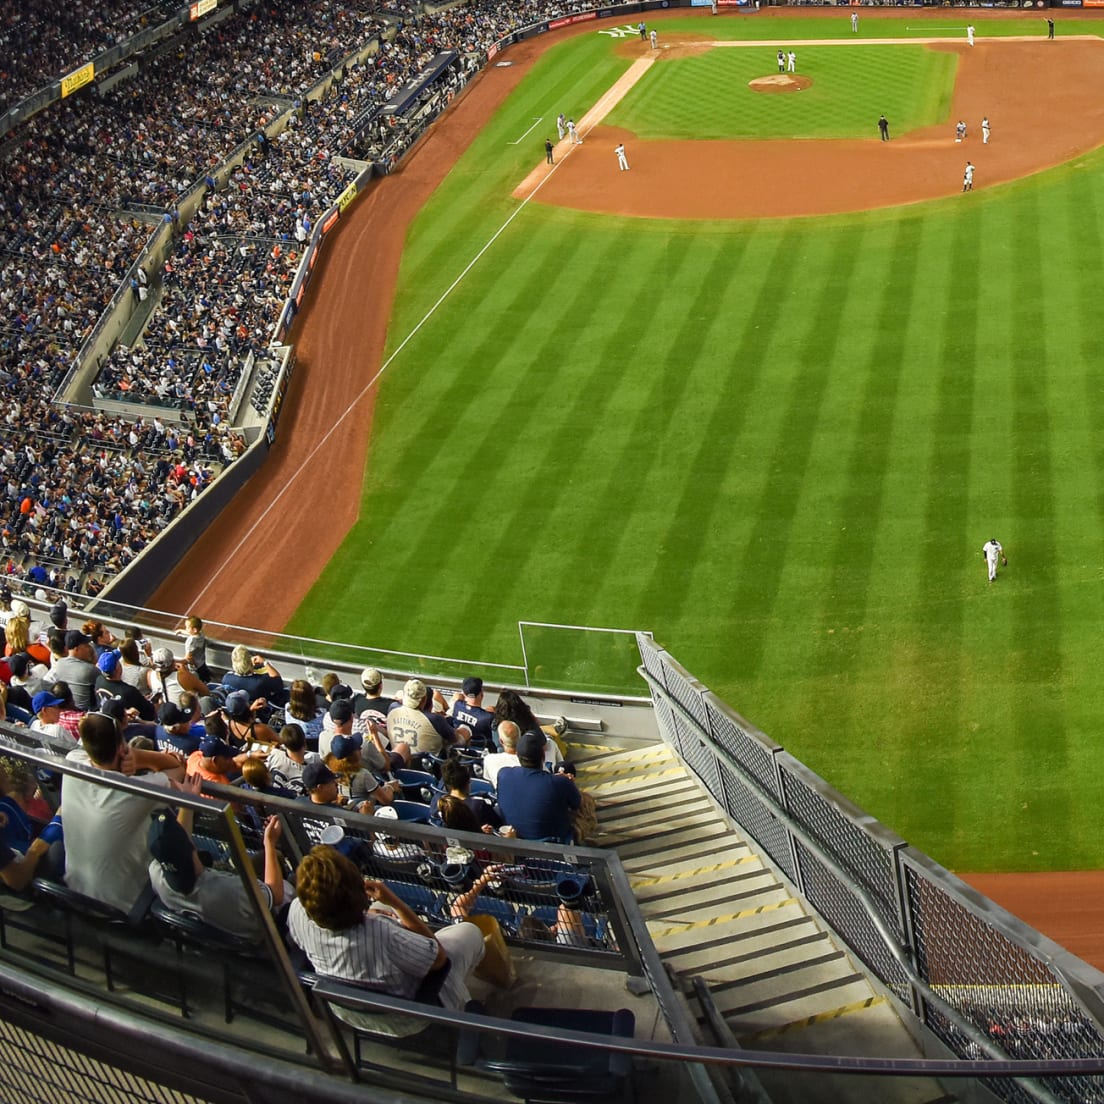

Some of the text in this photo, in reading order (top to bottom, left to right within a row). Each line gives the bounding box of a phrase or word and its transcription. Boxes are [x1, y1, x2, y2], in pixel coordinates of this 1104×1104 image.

[393, 717, 422, 730] MATTINGLY
[456, 711, 479, 727] JETER
[393, 726, 418, 748] 23
